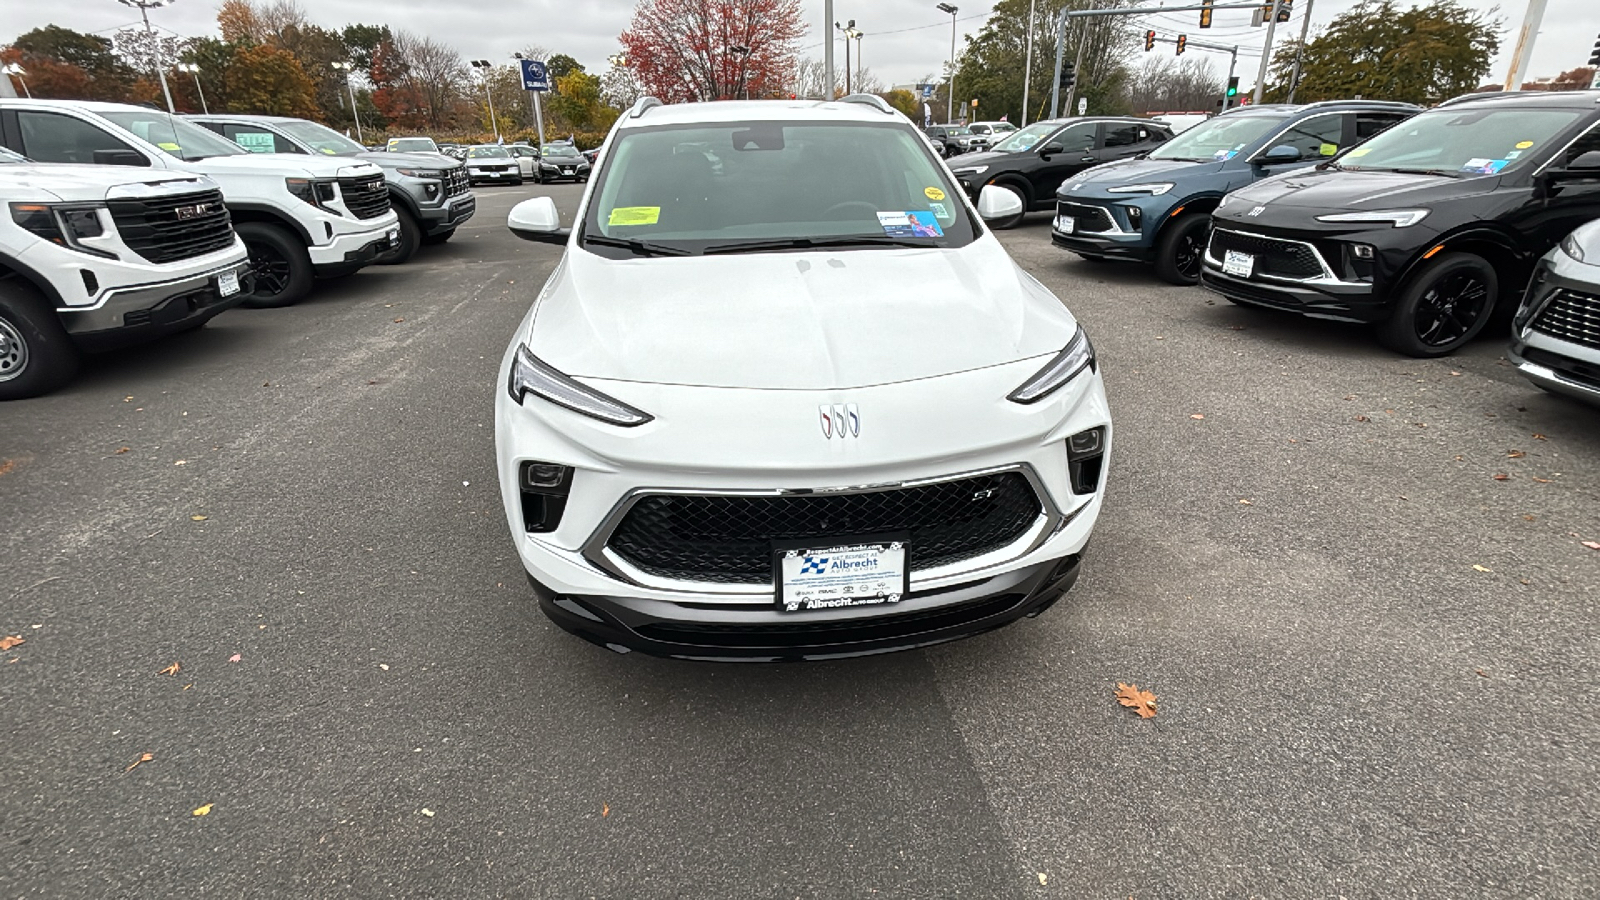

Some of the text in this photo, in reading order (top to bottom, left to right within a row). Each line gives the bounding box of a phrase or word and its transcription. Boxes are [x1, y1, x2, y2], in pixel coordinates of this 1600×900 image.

[175, 203, 214, 220] GMC
[831, 558, 878, 569] Albrecht
[806, 597, 852, 609] Albrecht
